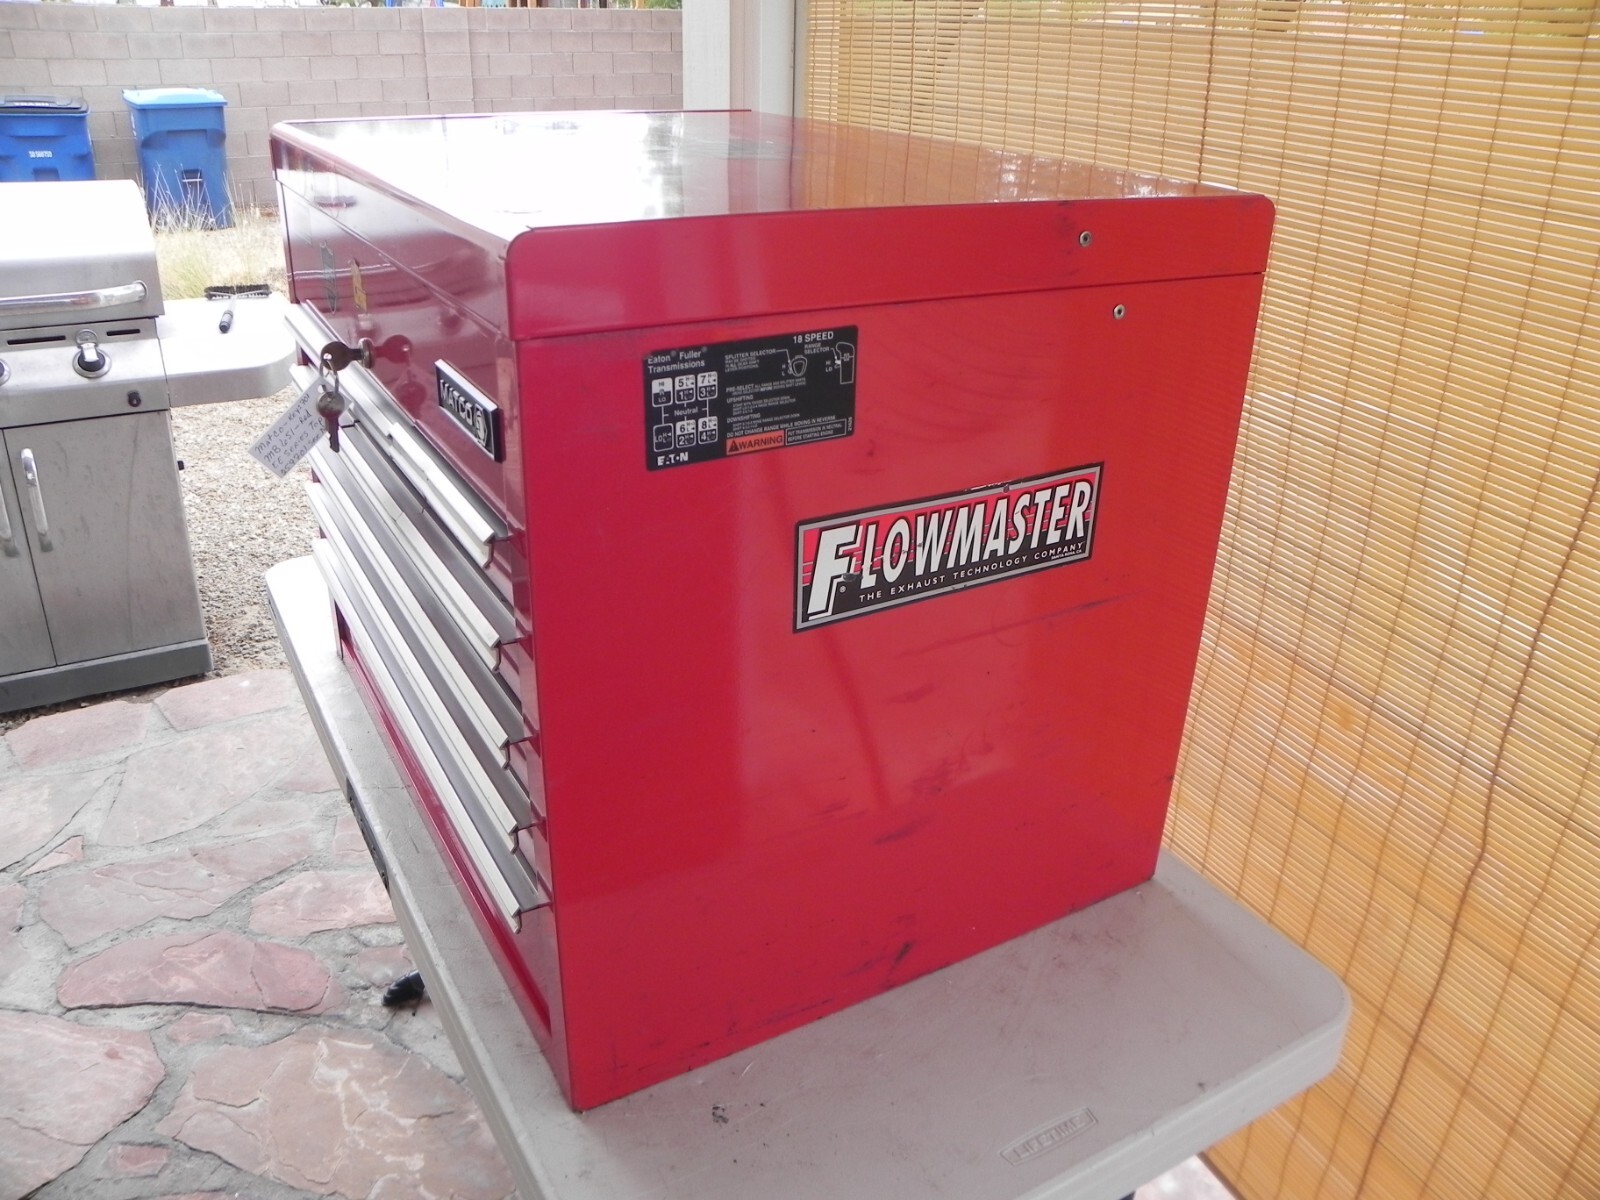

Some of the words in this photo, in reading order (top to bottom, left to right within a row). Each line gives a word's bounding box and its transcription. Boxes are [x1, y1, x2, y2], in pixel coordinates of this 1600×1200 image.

[793, 335, 803, 344] 18
[804, 331, 834, 342] SPEED
[725, 352, 749, 360] SPLITTER
[750, 348, 776, 356] SELECTOR
[804, 346, 830, 355] SELECTOR
[648, 355, 671, 364] Eaton
[680, 350, 701, 360] Fuller
[648, 360, 705, 374] Transmissions
[678, 379, 684, 387] 5
[700, 375, 706, 384] 7
[726, 383, 754, 392] PRE-SELECT
[679, 391, 684, 400] 1
[700, 388, 706, 397] 3
[440, 379, 473, 426] MATCO
[726, 394, 753, 403] UPSHIFTING
[674, 406, 698, 416] Neutral
[726, 413, 760, 423] DOWNSHIFTING
[680, 424, 685, 433] 6
[702, 420, 707, 429] 8
[679, 436, 685, 445] 2
[701, 432, 707, 440] 4
[738, 435, 783, 449] WARNING
[807, 480, 1093, 616] FLOWMASTER
[858, 590, 882, 603] THE
[890, 576, 946, 596] EXHAUST
[952, 555, 1028, 580] TECHNOLOGY
[1034, 542, 1083, 560] COMPANY
